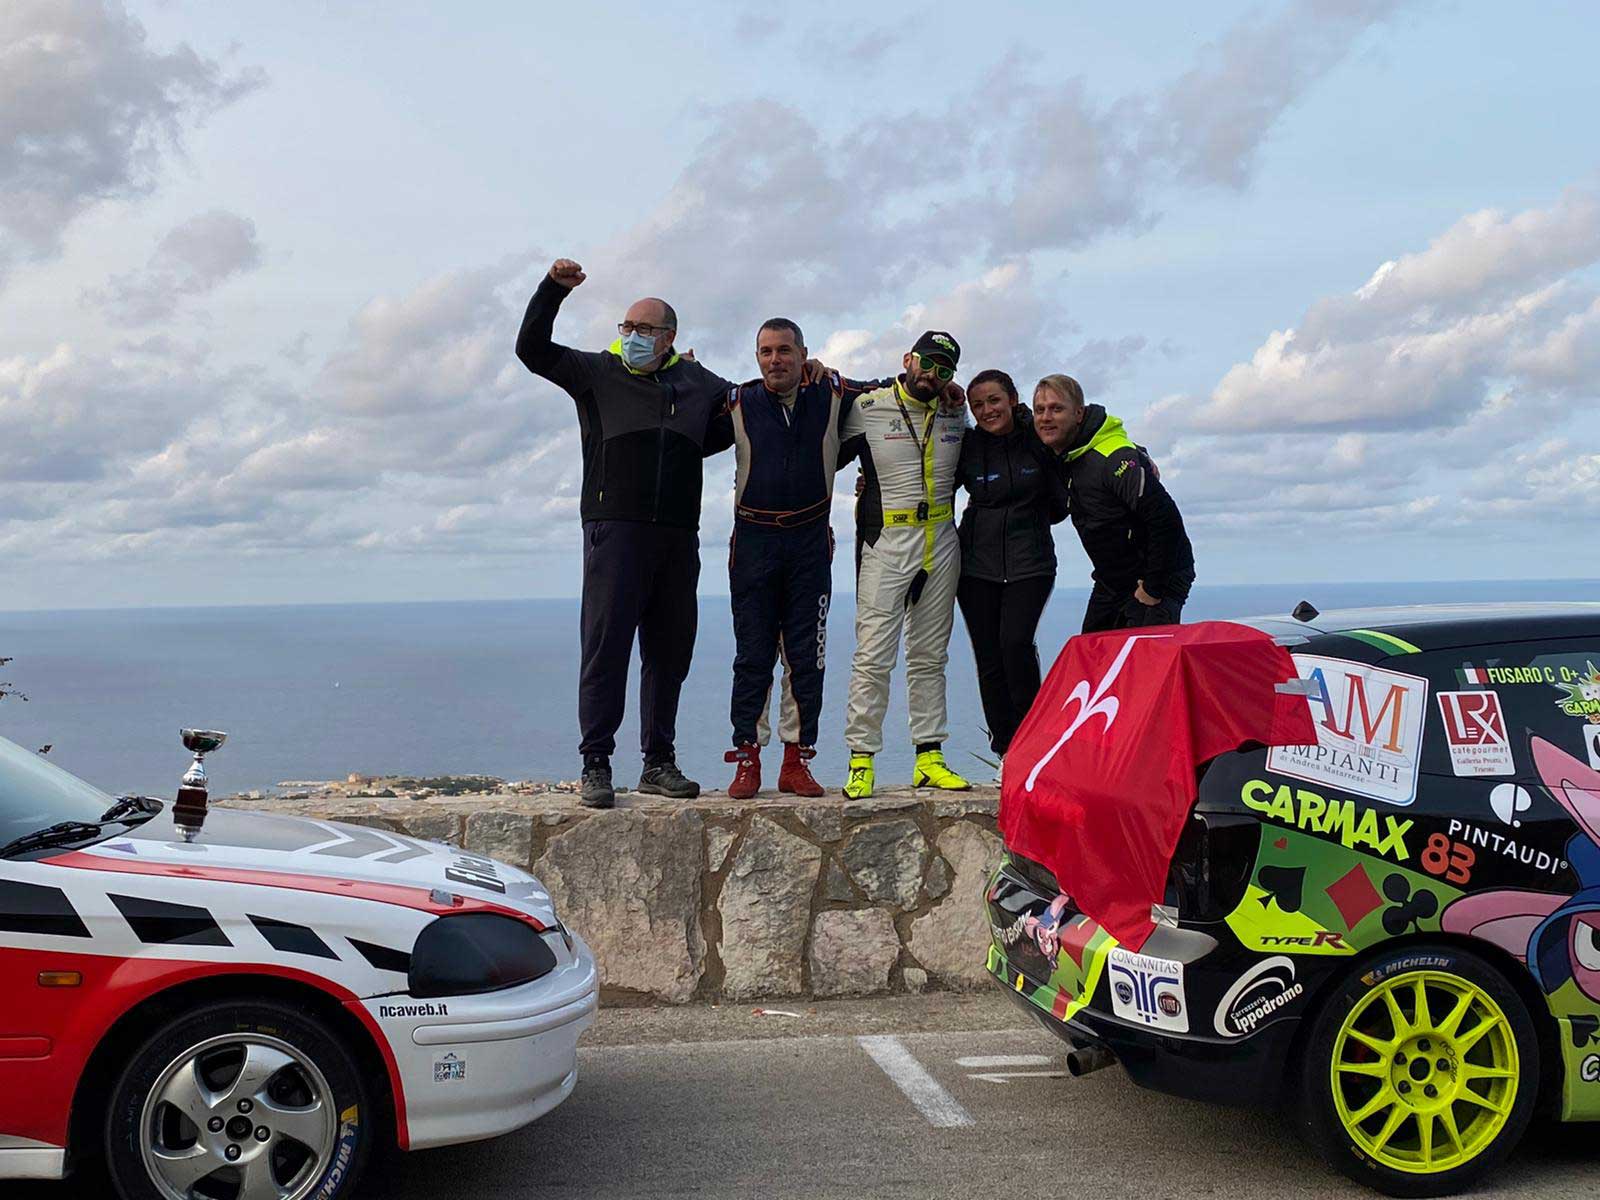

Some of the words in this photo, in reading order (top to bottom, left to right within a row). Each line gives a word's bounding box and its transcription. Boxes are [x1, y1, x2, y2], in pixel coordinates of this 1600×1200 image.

[816, 593, 828, 670] sparco
[1487, 666, 1543, 684] FUSARO
[1290, 755, 1321, 770] Andrea
[1241, 779, 1414, 861] CARMAX
[1420, 832, 1476, 885] 83
[1260, 936, 1312, 946] TYPE
[1312, 930, 1349, 950] R
[1112, 950, 1179, 975] CONCINNITAS
[1386, 956, 1451, 975] MICHELIN
[379, 1003, 449, 1018] ncaweb.it
[1230, 996, 1266, 1020] Carrozzeria
[1233, 983, 1304, 1033] Ippodromo
